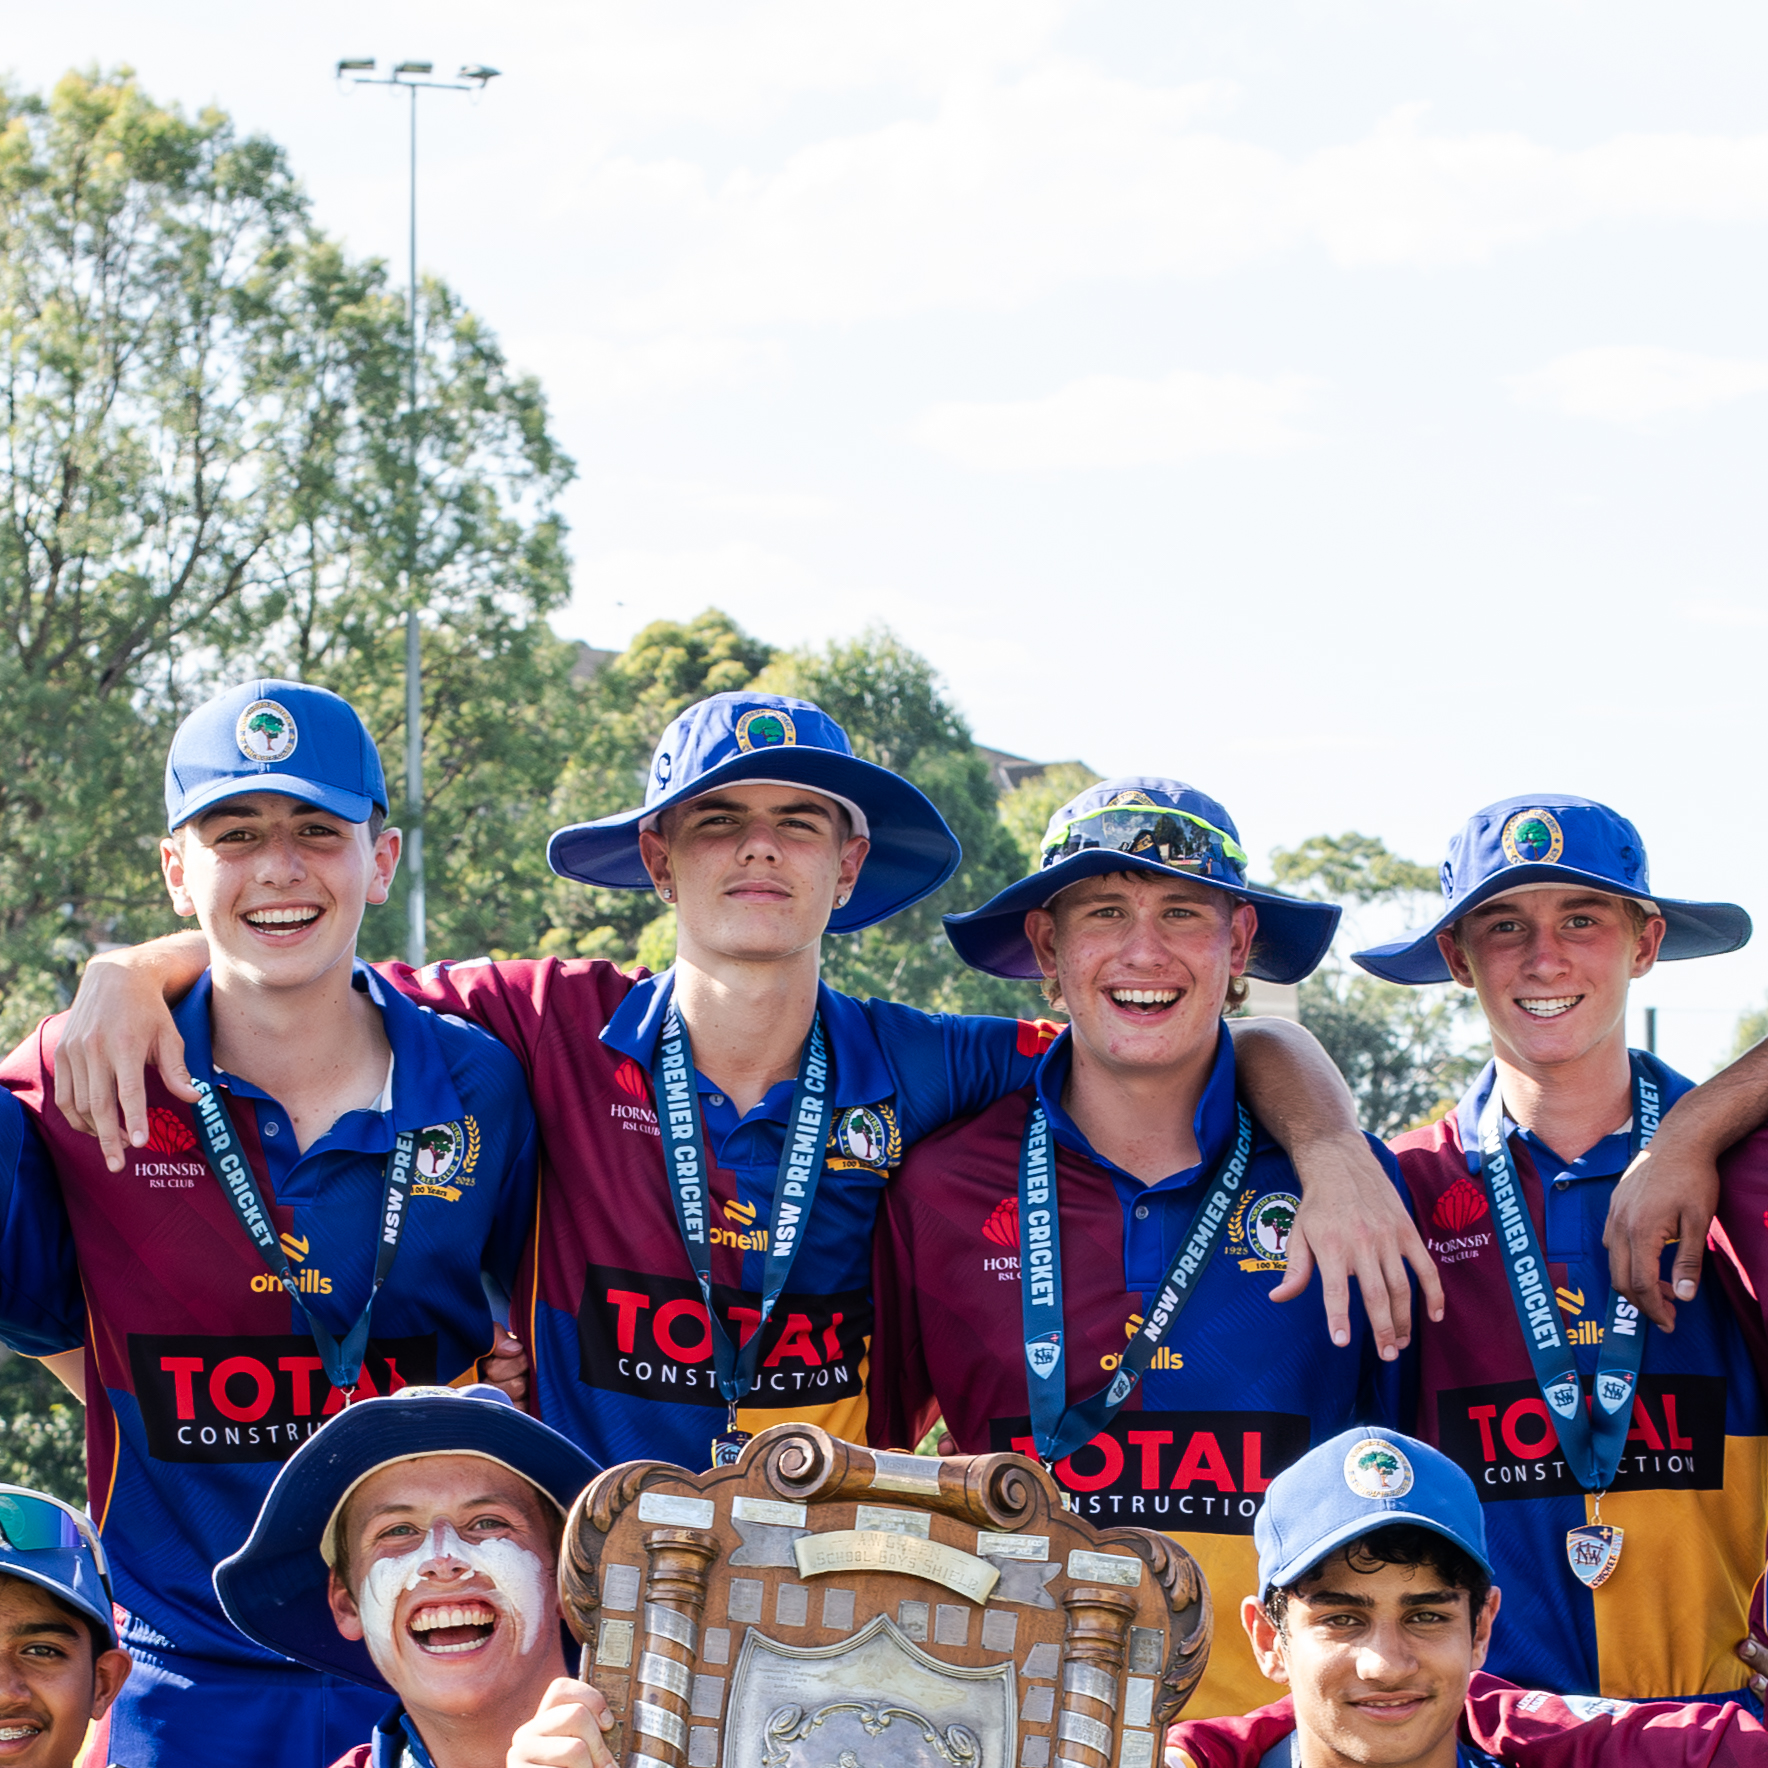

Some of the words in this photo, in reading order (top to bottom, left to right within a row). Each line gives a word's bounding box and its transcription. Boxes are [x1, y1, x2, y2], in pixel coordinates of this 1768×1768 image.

[661, 1042, 690, 1140] PREMIER
[623, 1120, 638, 1132] RSL
[640, 1123, 661, 1137] CLUB
[787, 1095, 825, 1198] PREMIER
[135, 1163, 206, 1178] HORNSBY
[150, 1179, 166, 1188] RSL
[168, 1178, 195, 1188] CLUB
[220, 1154, 274, 1248] CRICKET
[424, 1187, 448, 1198] Years
[674, 1145, 704, 1244] CRICKET
[383, 1188, 408, 1246] NSW
[773, 1202, 802, 1257] NSW
[1143, 1286, 1180, 1342] NSW
[1171, 1190, 1231, 1289] PREMIER
[1220, 1101, 1252, 1191] CRICKET
[710, 1227, 769, 1252] o'neill
[1027, 1210, 1055, 1306] CRICKET
[1225, 1246, 1249, 1255] 1925
[1427, 1232, 1492, 1255] HORNSBY
[1456, 1249, 1480, 1261] CLUB
[1487, 1158, 1529, 1255] PREMIER
[1513, 1256, 1562, 1351] CRICKET
[1255, 1262, 1269, 1271] 100
